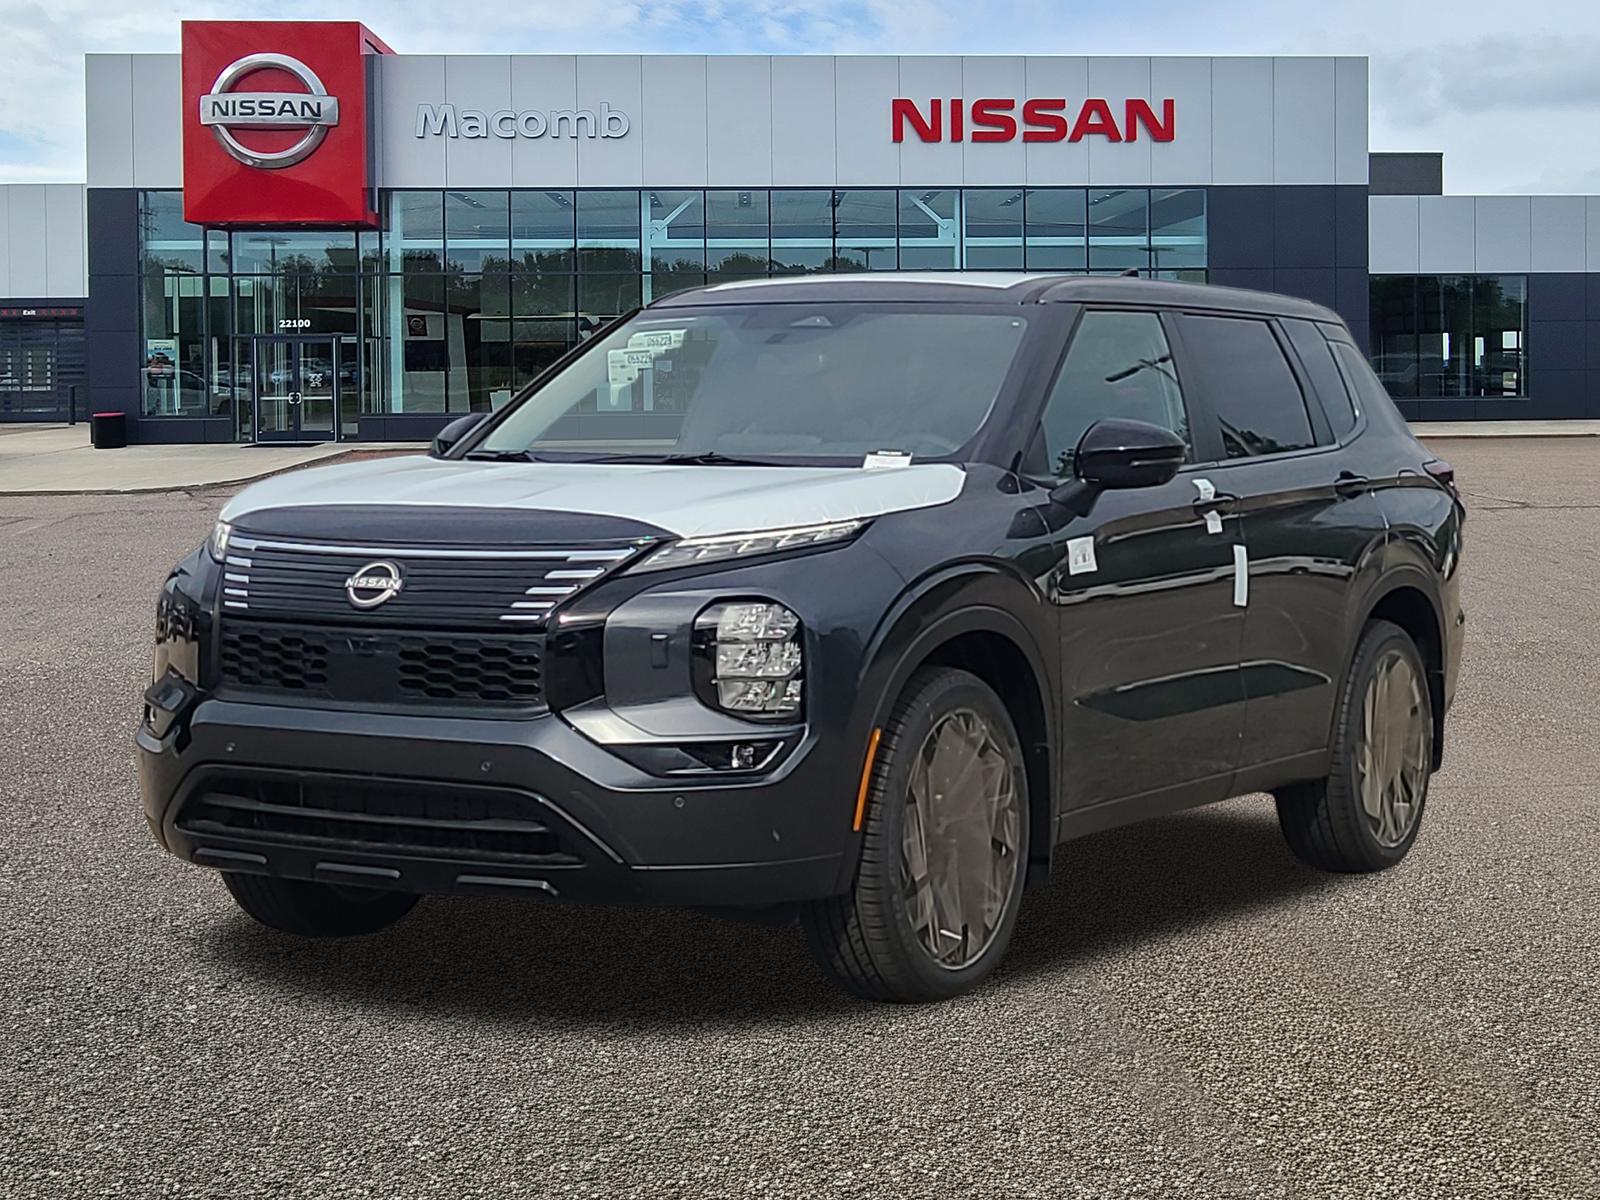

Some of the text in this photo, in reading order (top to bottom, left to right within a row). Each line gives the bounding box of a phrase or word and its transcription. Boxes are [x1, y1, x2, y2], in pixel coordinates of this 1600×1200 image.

[211, 100, 321, 117] NISSAN
[415, 102, 630, 138] Macomb
[892, 98, 1175, 143] NISSAN
[279, 319, 311, 328] 22100
[344, 577, 402, 590] NISSAN
